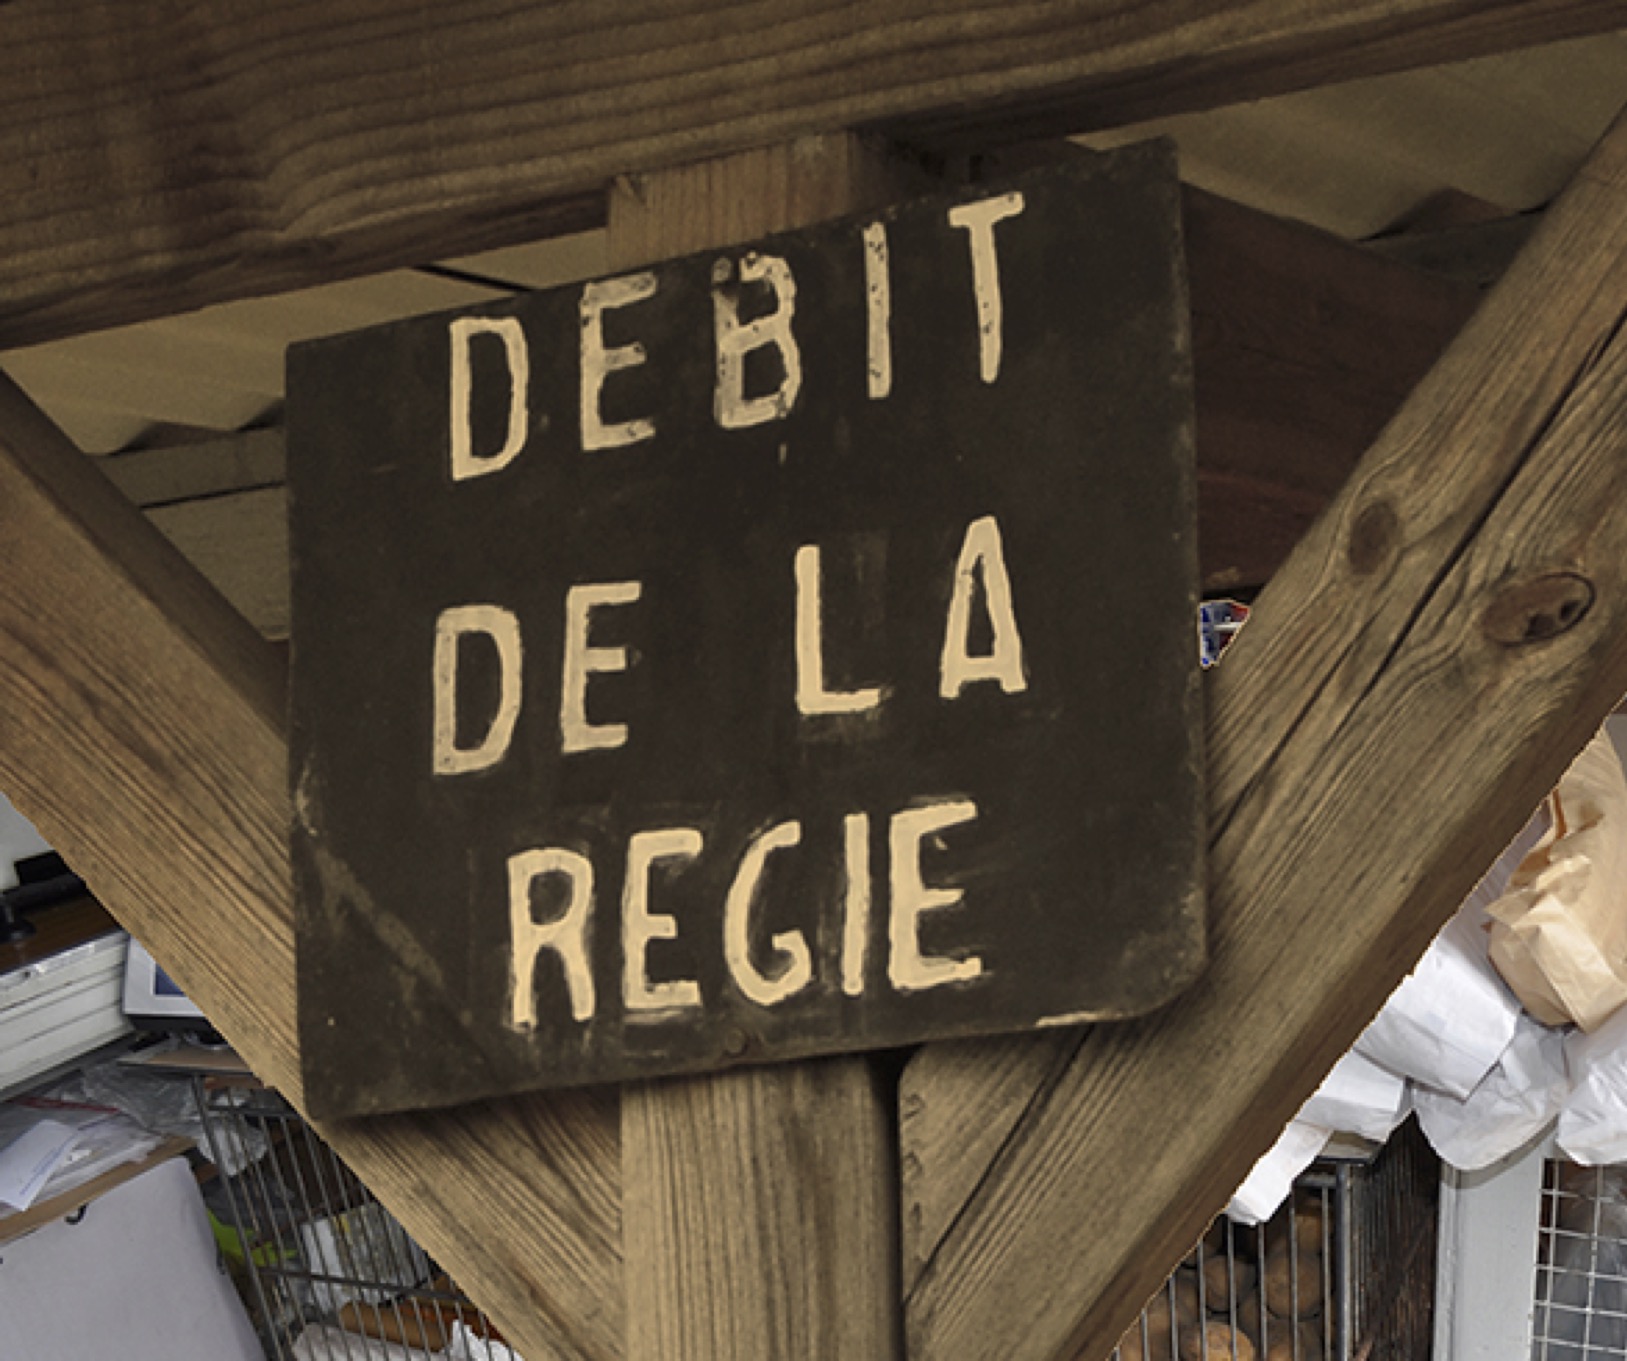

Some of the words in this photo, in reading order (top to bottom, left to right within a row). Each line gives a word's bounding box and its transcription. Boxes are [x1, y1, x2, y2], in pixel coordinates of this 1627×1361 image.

[448, 190, 1025, 482] DEBIT
[432, 580, 642, 776] DE
[795, 515, 1027, 714] LA
[507, 801, 983, 1029] REGIE
